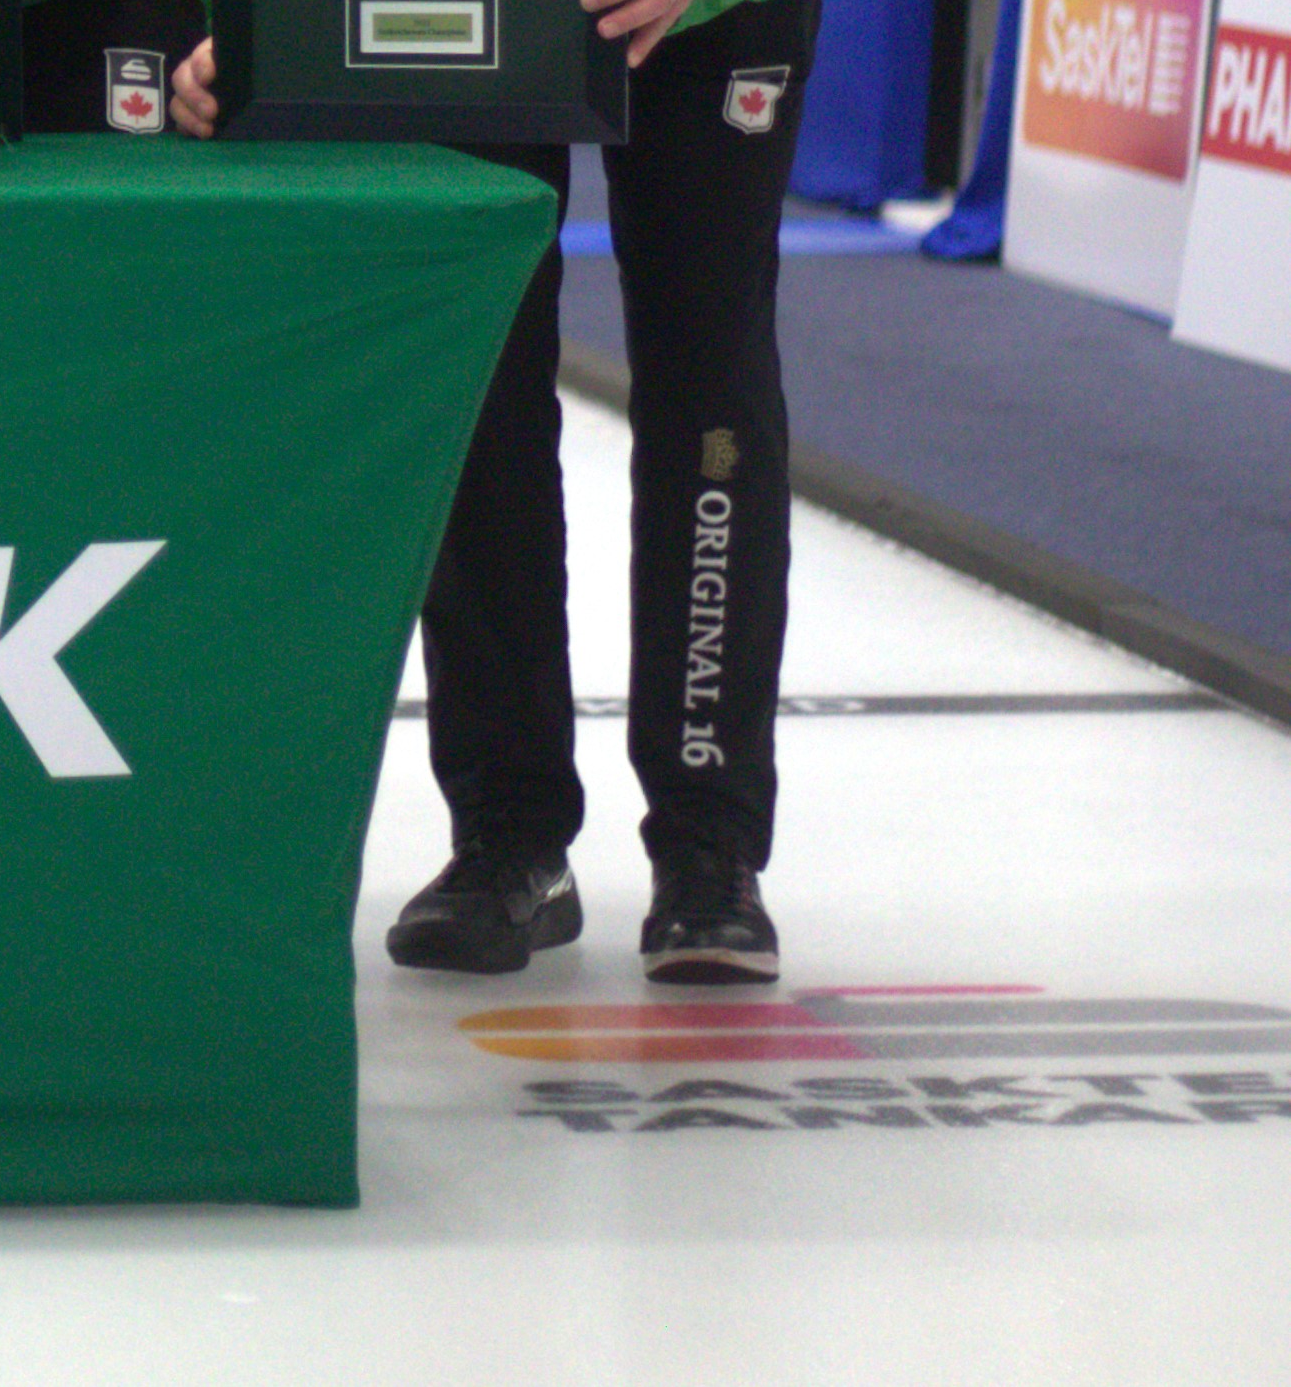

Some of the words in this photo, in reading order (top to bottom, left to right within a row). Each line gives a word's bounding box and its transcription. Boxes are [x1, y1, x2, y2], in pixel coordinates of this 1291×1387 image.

[1208, 42, 1291, 154] PHA
[684, 489, 732, 710] ORIGINAL
[681, 719, 725, 768] 16
[522, 1072, 1291, 1105] SASKTE
